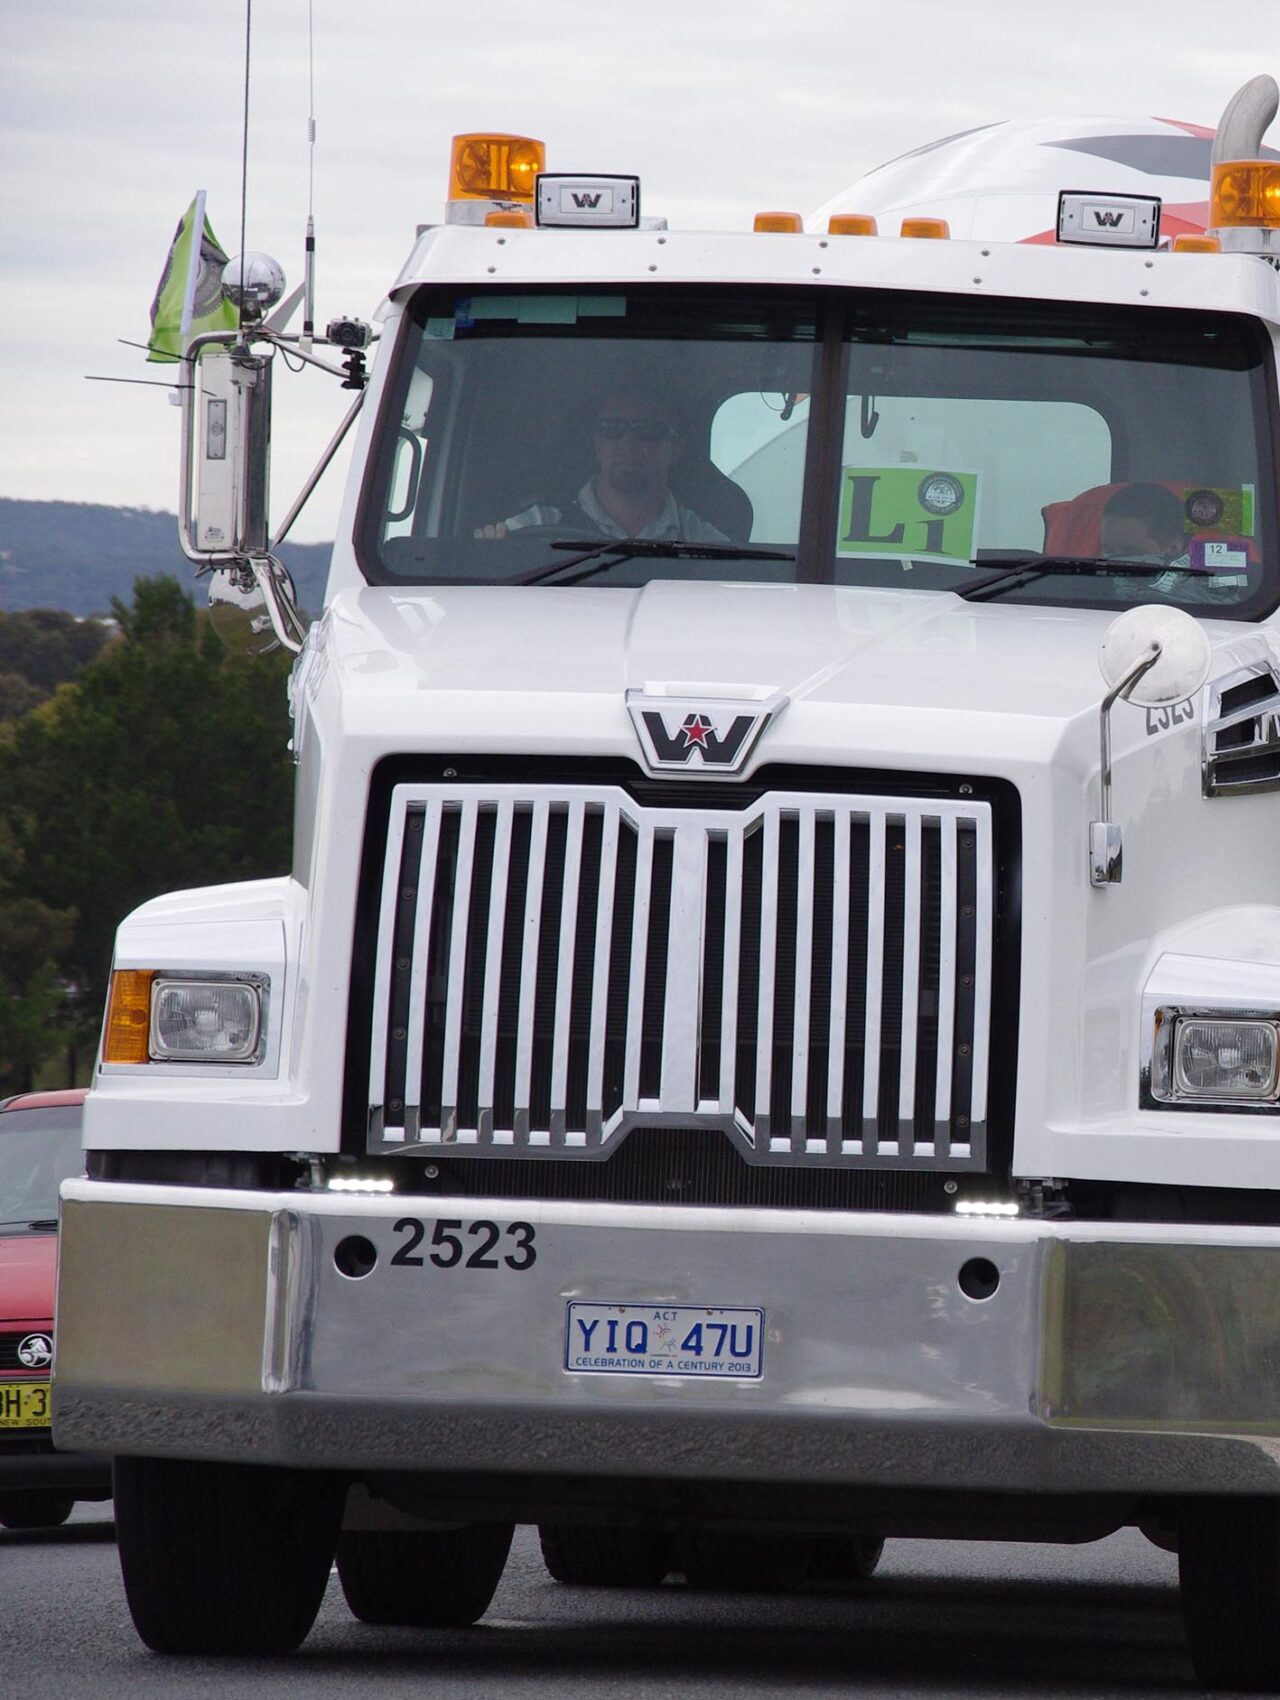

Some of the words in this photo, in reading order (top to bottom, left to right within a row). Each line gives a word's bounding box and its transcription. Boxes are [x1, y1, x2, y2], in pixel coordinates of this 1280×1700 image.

[1210, 545, 1223, 554] 12
[390, 1217, 537, 1271] 2523
[653, 1311, 678, 1321] ACT
[577, 1318, 648, 1354] YIQ
[680, 1323, 753, 1358] 47U
[576, 1357, 645, 1369] CELEBRATION
[649, 1359, 663, 1369] OF
[666, 1360, 674, 1369] A
[678, 1360, 724, 1371] CENTURY
[728, 1362, 751, 1372] 2013
